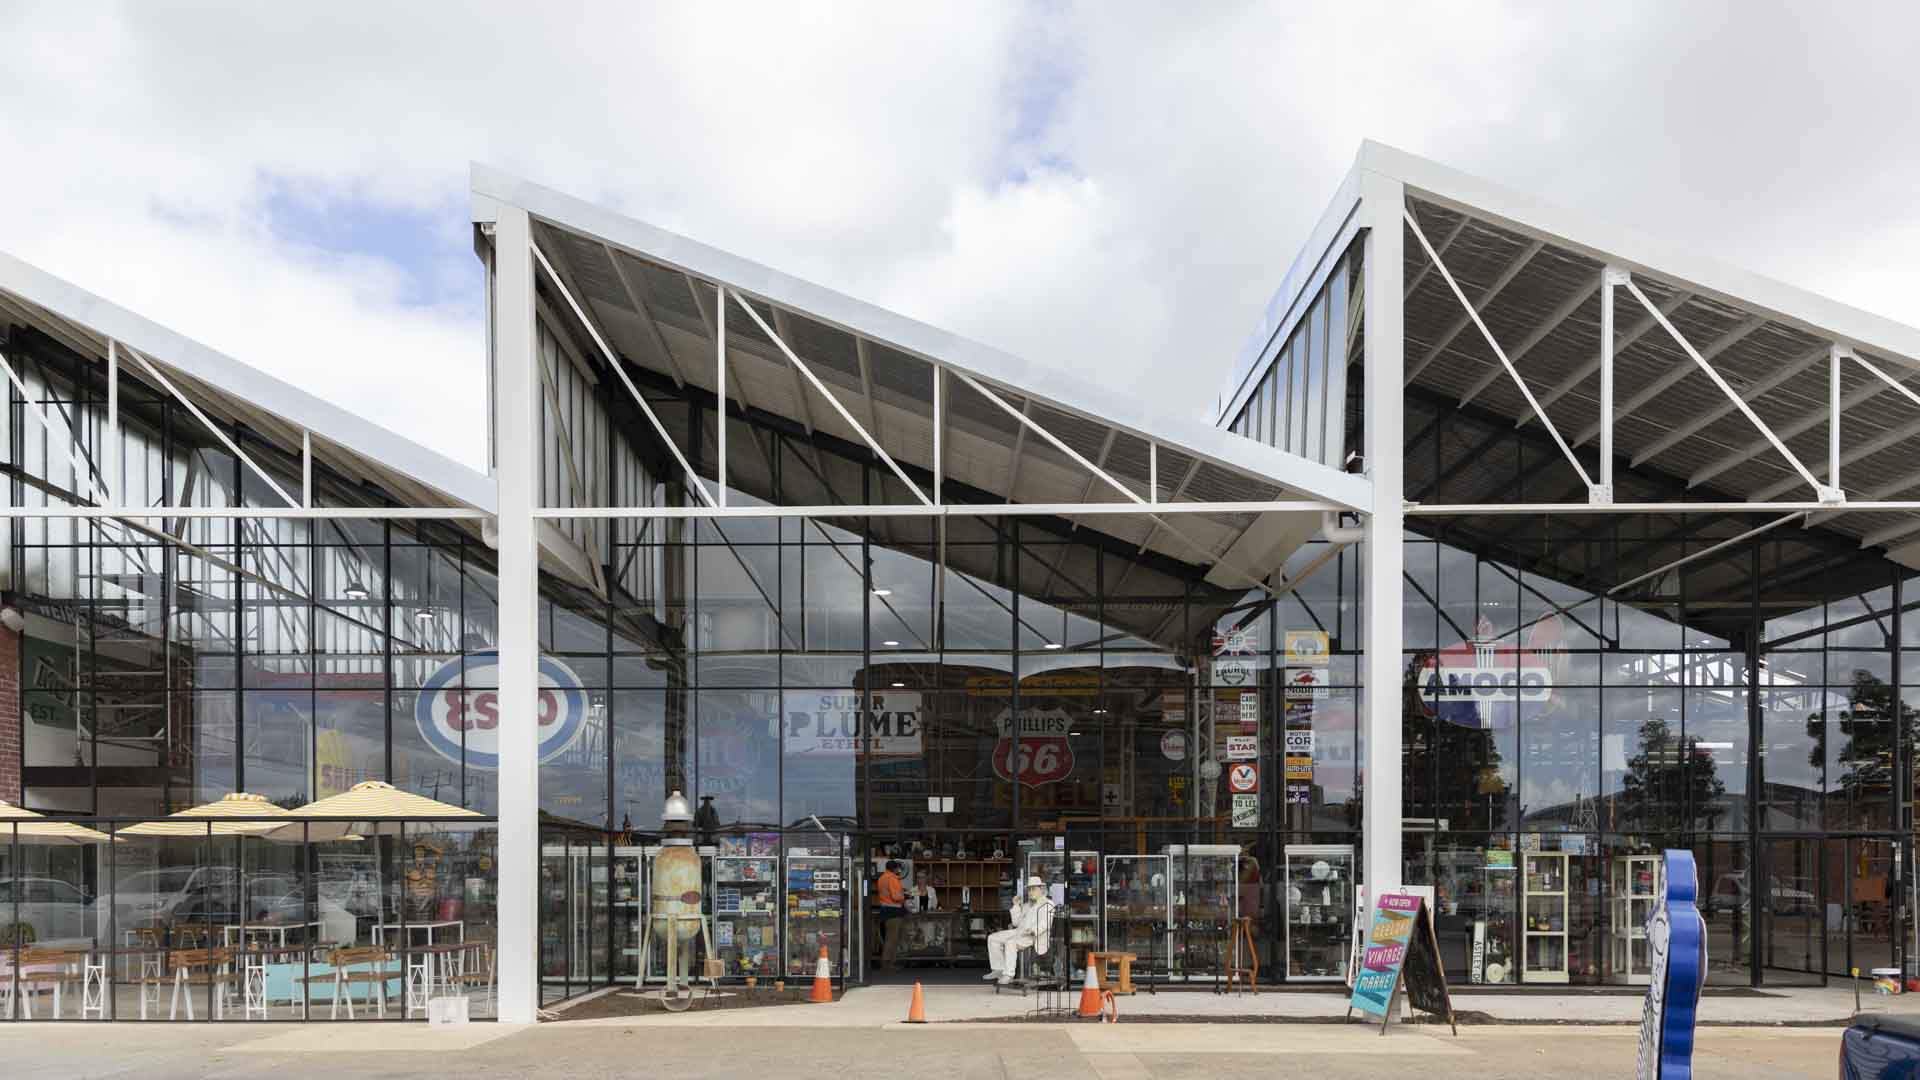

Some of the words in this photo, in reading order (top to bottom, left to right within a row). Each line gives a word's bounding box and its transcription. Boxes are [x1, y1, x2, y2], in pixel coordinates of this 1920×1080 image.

[1423, 672, 1545, 697] AMOCO
[788, 711, 917, 737] PLUME
[1228, 743, 1257, 751] STAR
[1286, 737, 1311, 745] COR
[1006, 743, 1059, 775] 66
[1368, 946, 1403, 964] VINTAGE
[1359, 973, 1394, 991] MARKET
